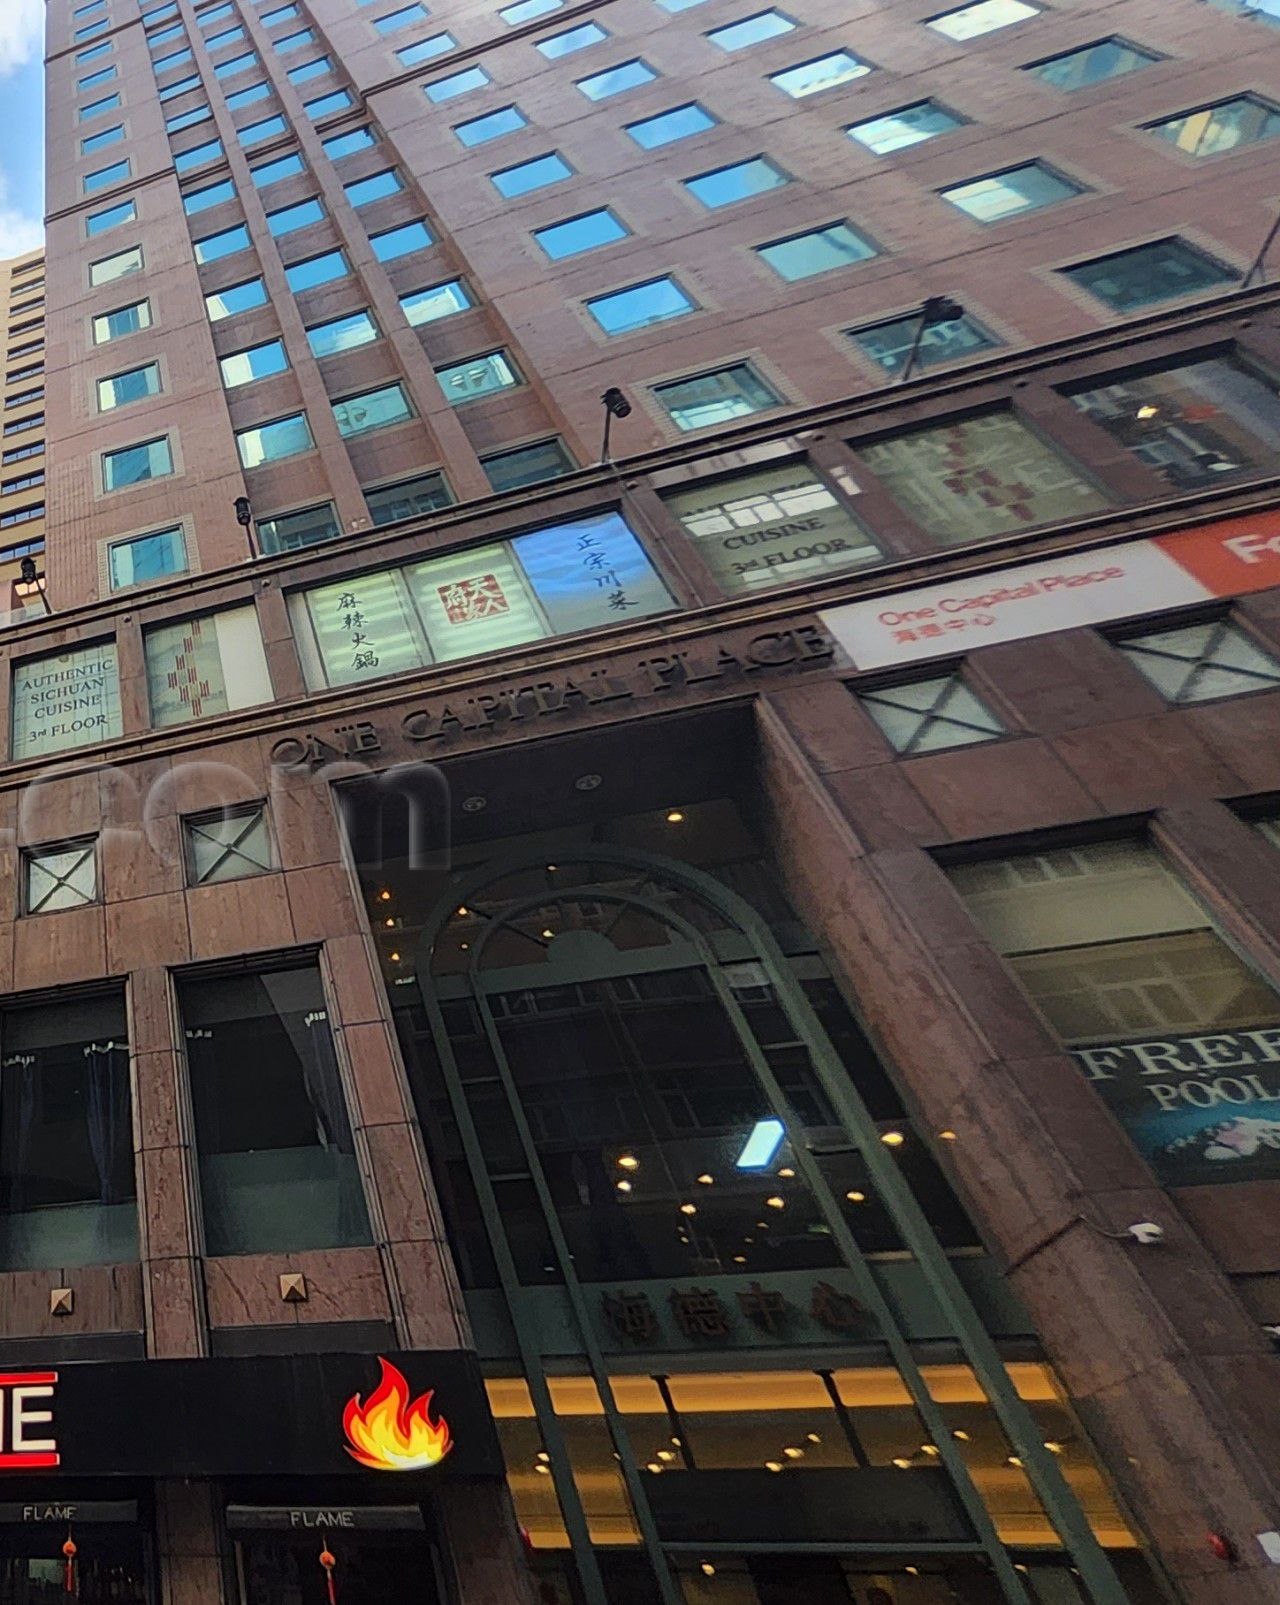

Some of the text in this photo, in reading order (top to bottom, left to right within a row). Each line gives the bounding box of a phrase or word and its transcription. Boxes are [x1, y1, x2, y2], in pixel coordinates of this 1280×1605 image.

[723, 517, 826, 550] CUISINE
[763, 537, 852, 568] FLOOR
[576, 533, 638, 611] 正宗川菜
[878, 567, 1126, 627] One Capital Place
[336, 591, 380, 671] 麻辣火鍋
[22, 659, 114, 691] AUTHENTIC
[30, 677, 104, 705] SICHUAN
[34, 694, 103, 719] CUISINE
[269, 623, 835, 768] ONE CAPITAL PLACE
[29, 714, 109, 743] 3rd FLOOR
[23, 1506, 77, 1521] FLAME
[289, 1511, 355, 1527] FLAME
